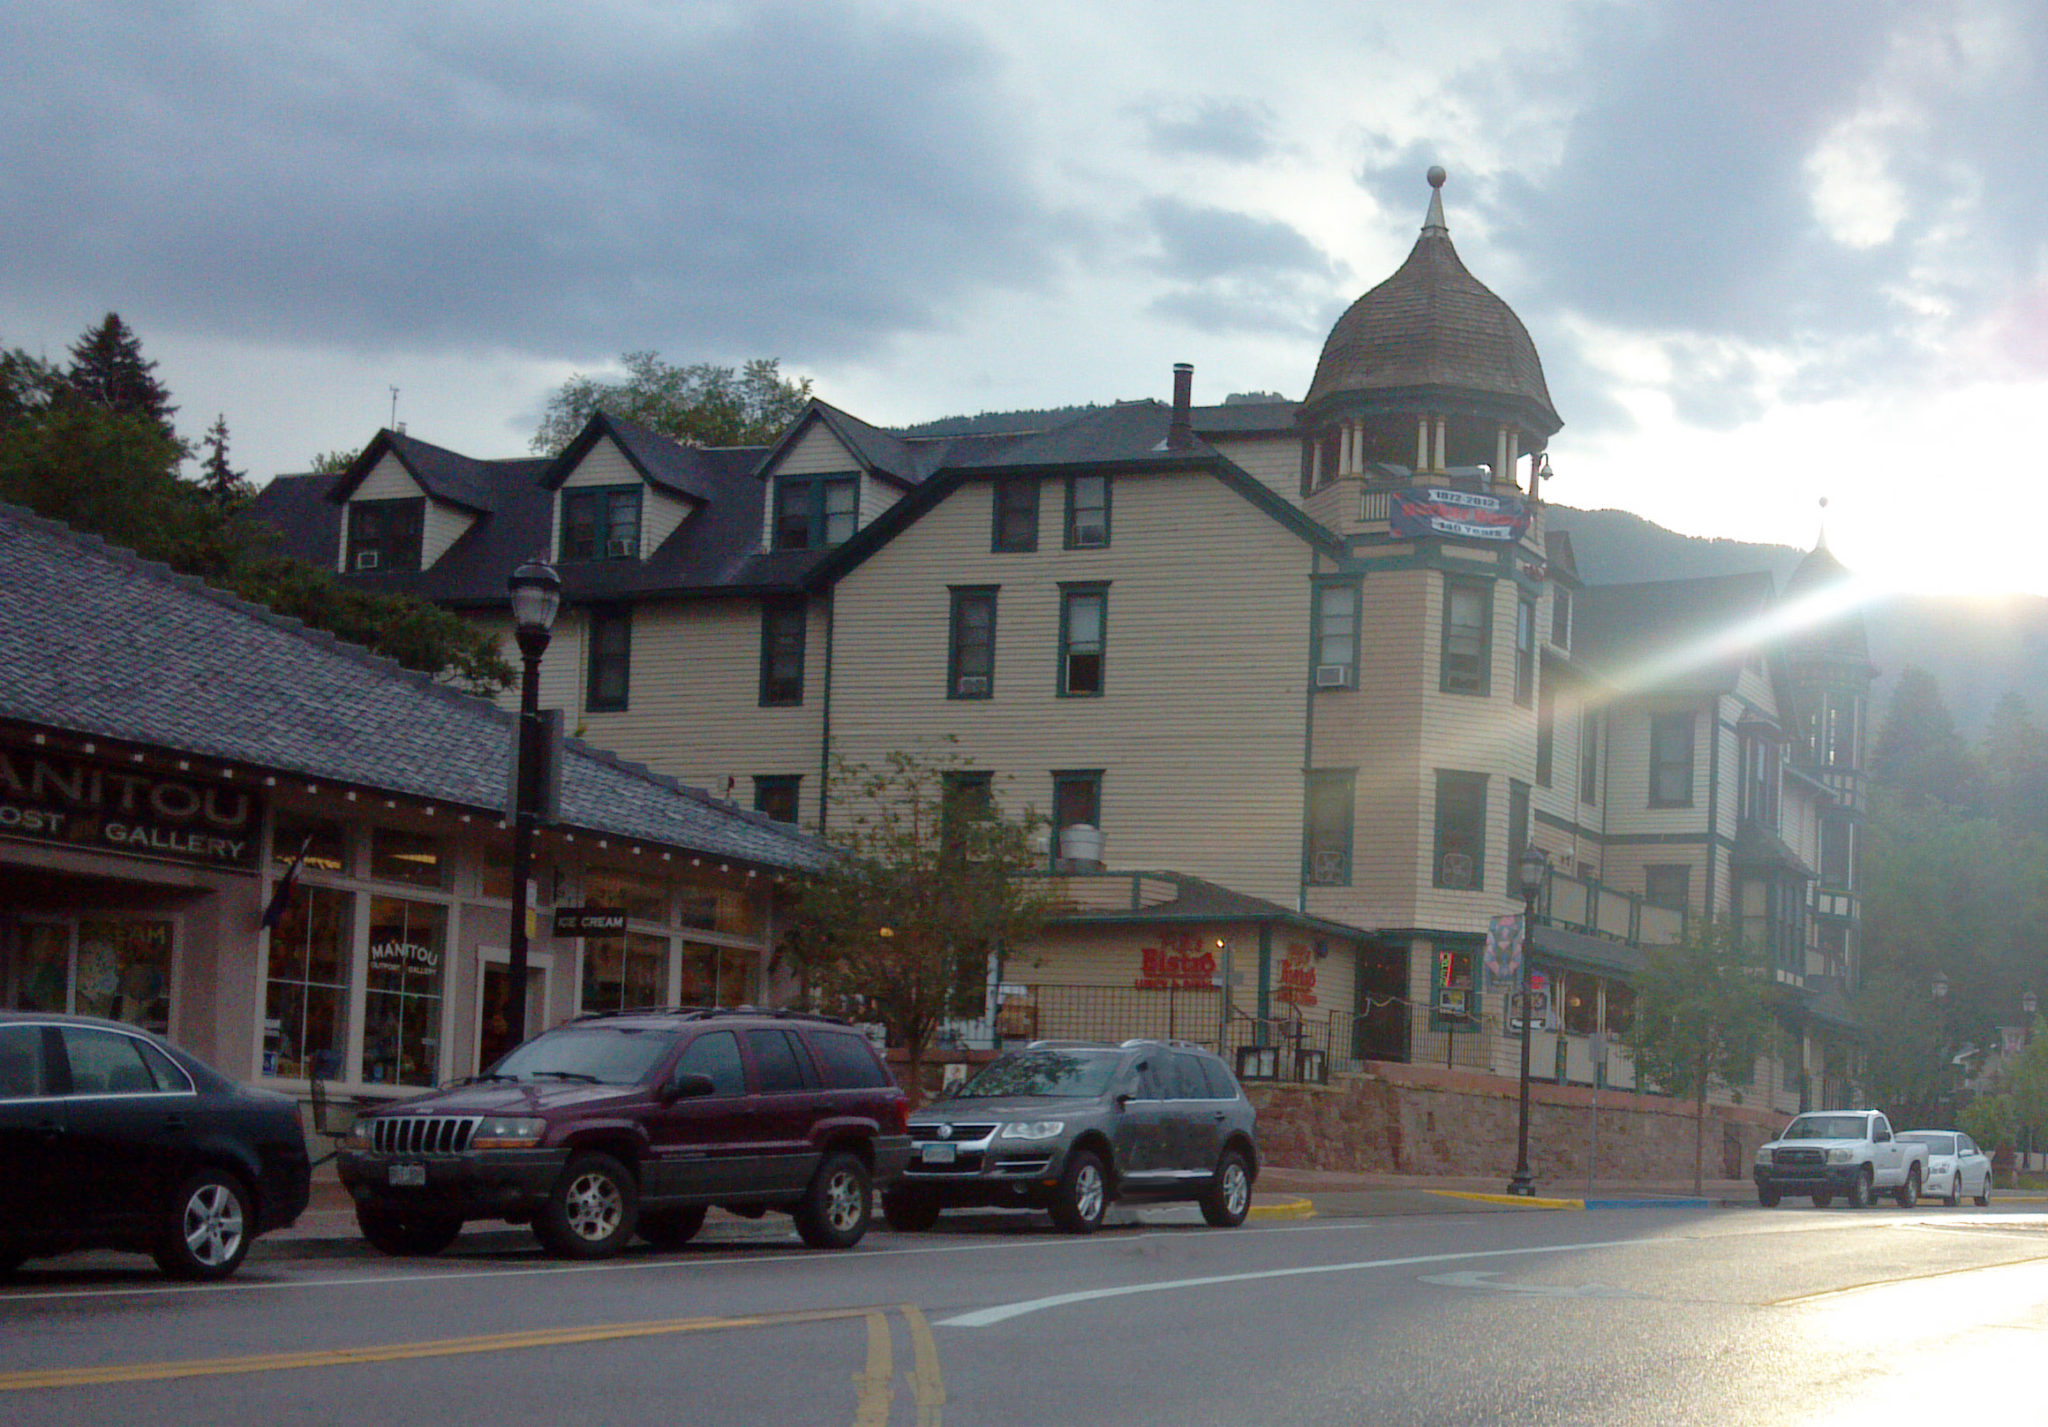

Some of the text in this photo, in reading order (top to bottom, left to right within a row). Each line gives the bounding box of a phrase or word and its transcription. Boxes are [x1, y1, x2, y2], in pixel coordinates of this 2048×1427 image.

[105, 823, 245, 858] GALLERY
[558, 916, 624, 929] ICE CREAM
[371, 942, 438, 966] MANITOU
[1141, 948, 1217, 974] Bistro
